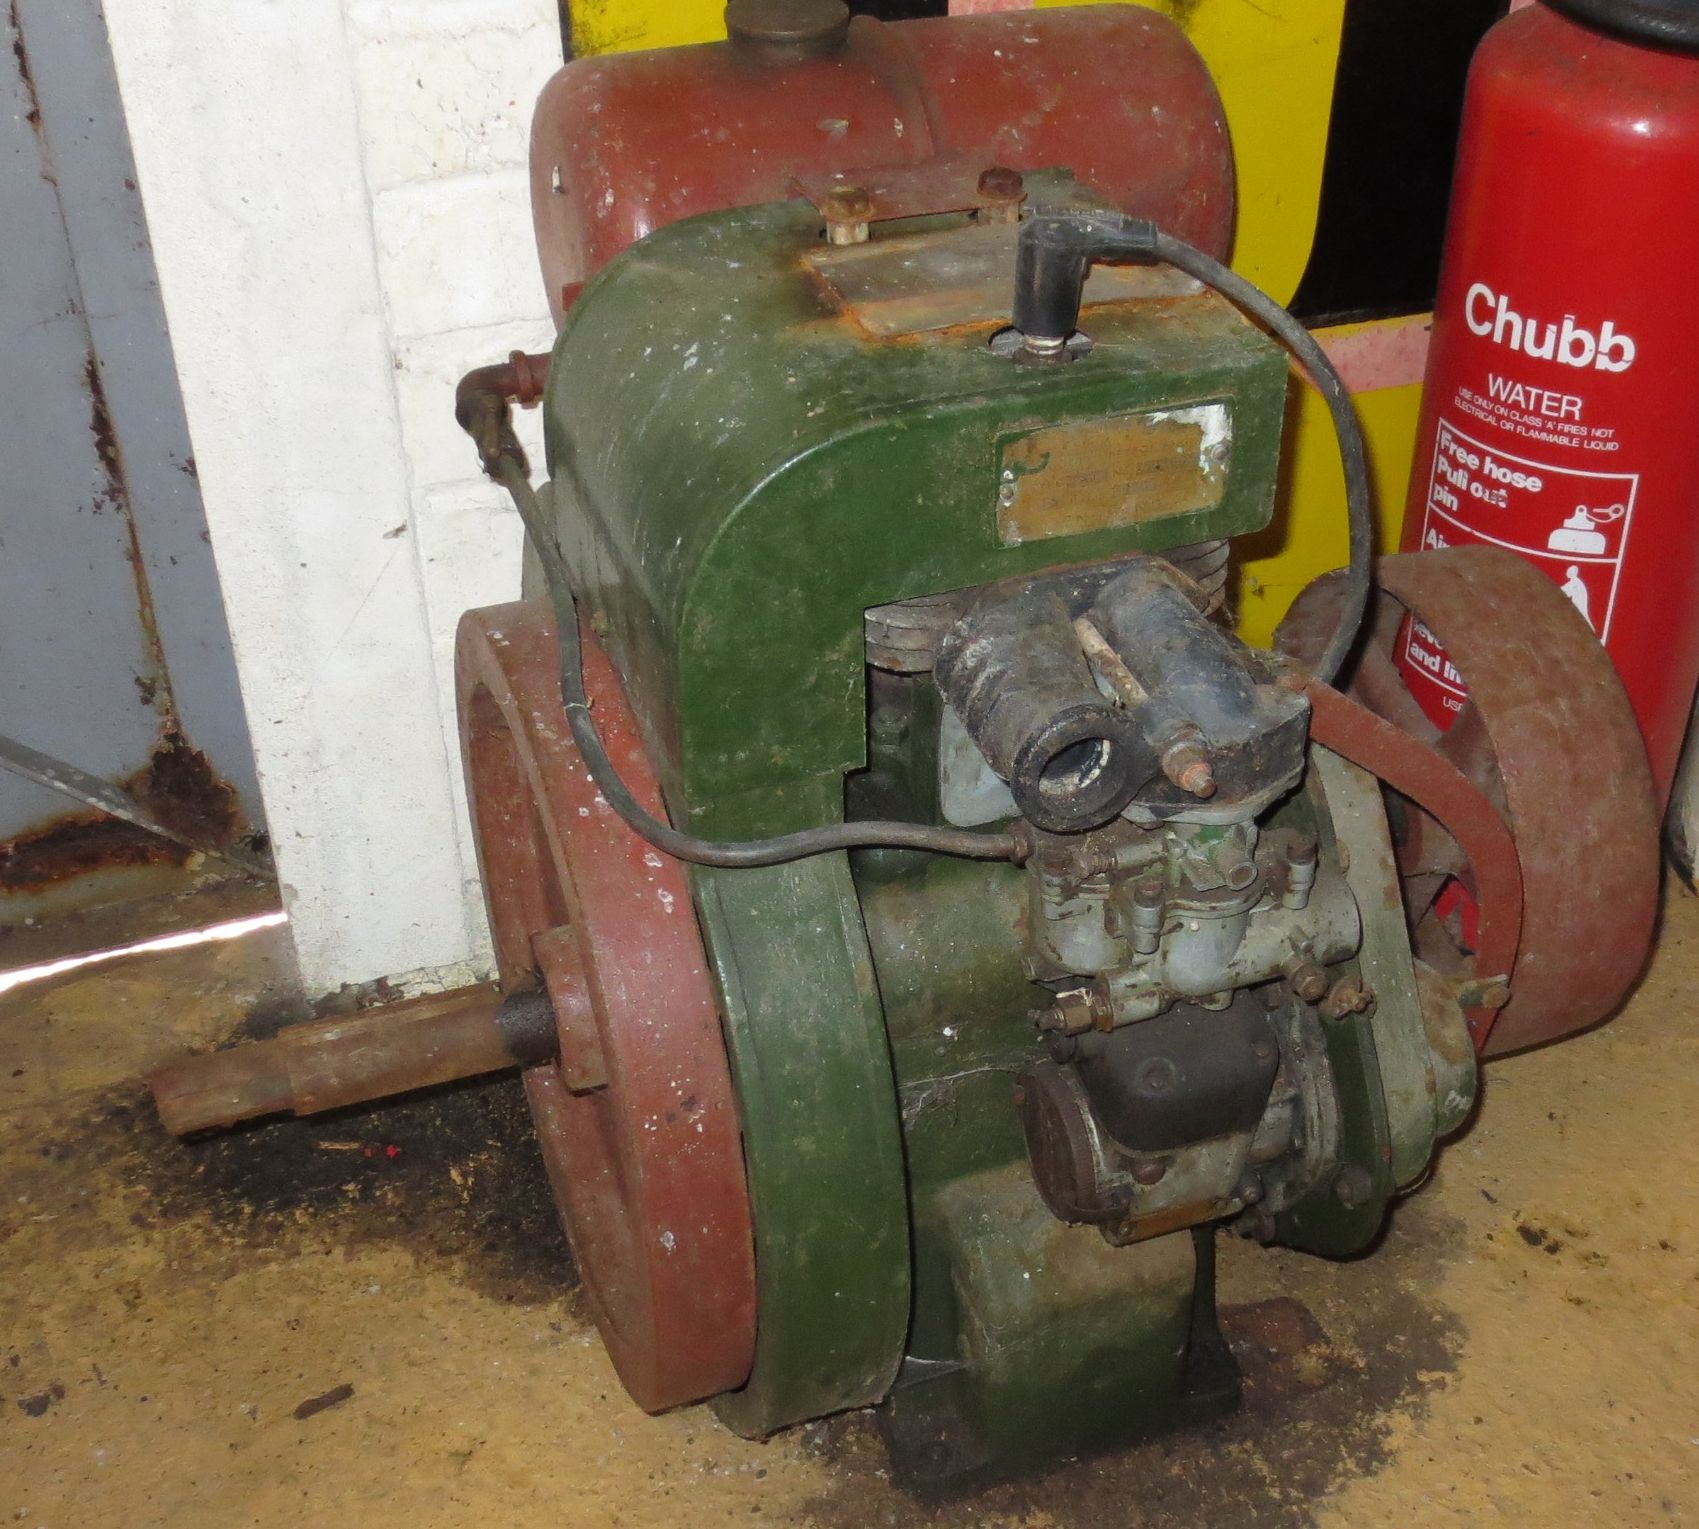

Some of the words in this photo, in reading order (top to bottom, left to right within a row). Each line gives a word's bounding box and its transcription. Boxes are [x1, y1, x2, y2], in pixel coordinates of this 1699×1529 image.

[1465, 283, 1635, 372] Chubb
[1473, 395, 1495, 410] ONLY
[1494, 405, 1509, 417] ON
[1510, 410, 1543, 427] CLASS
[1557, 422, 1587, 436] FIRES
[1591, 427, 1616, 438] NOT
[1488, 372, 1583, 421] WATER
[1454, 395, 1498, 426] ELECTRICAL
[1500, 420, 1515, 432] OR
[1516, 425, 1580, 447] FLAMMABLE
[1583, 439, 1619, 451] LIQUID
[1437, 454, 1468, 491] Pull
[1440, 430, 1480, 470] Free
[1484, 456, 1543, 492] hose
[1433, 482, 1459, 512] pin
[1410, 642, 1441, 673] and
